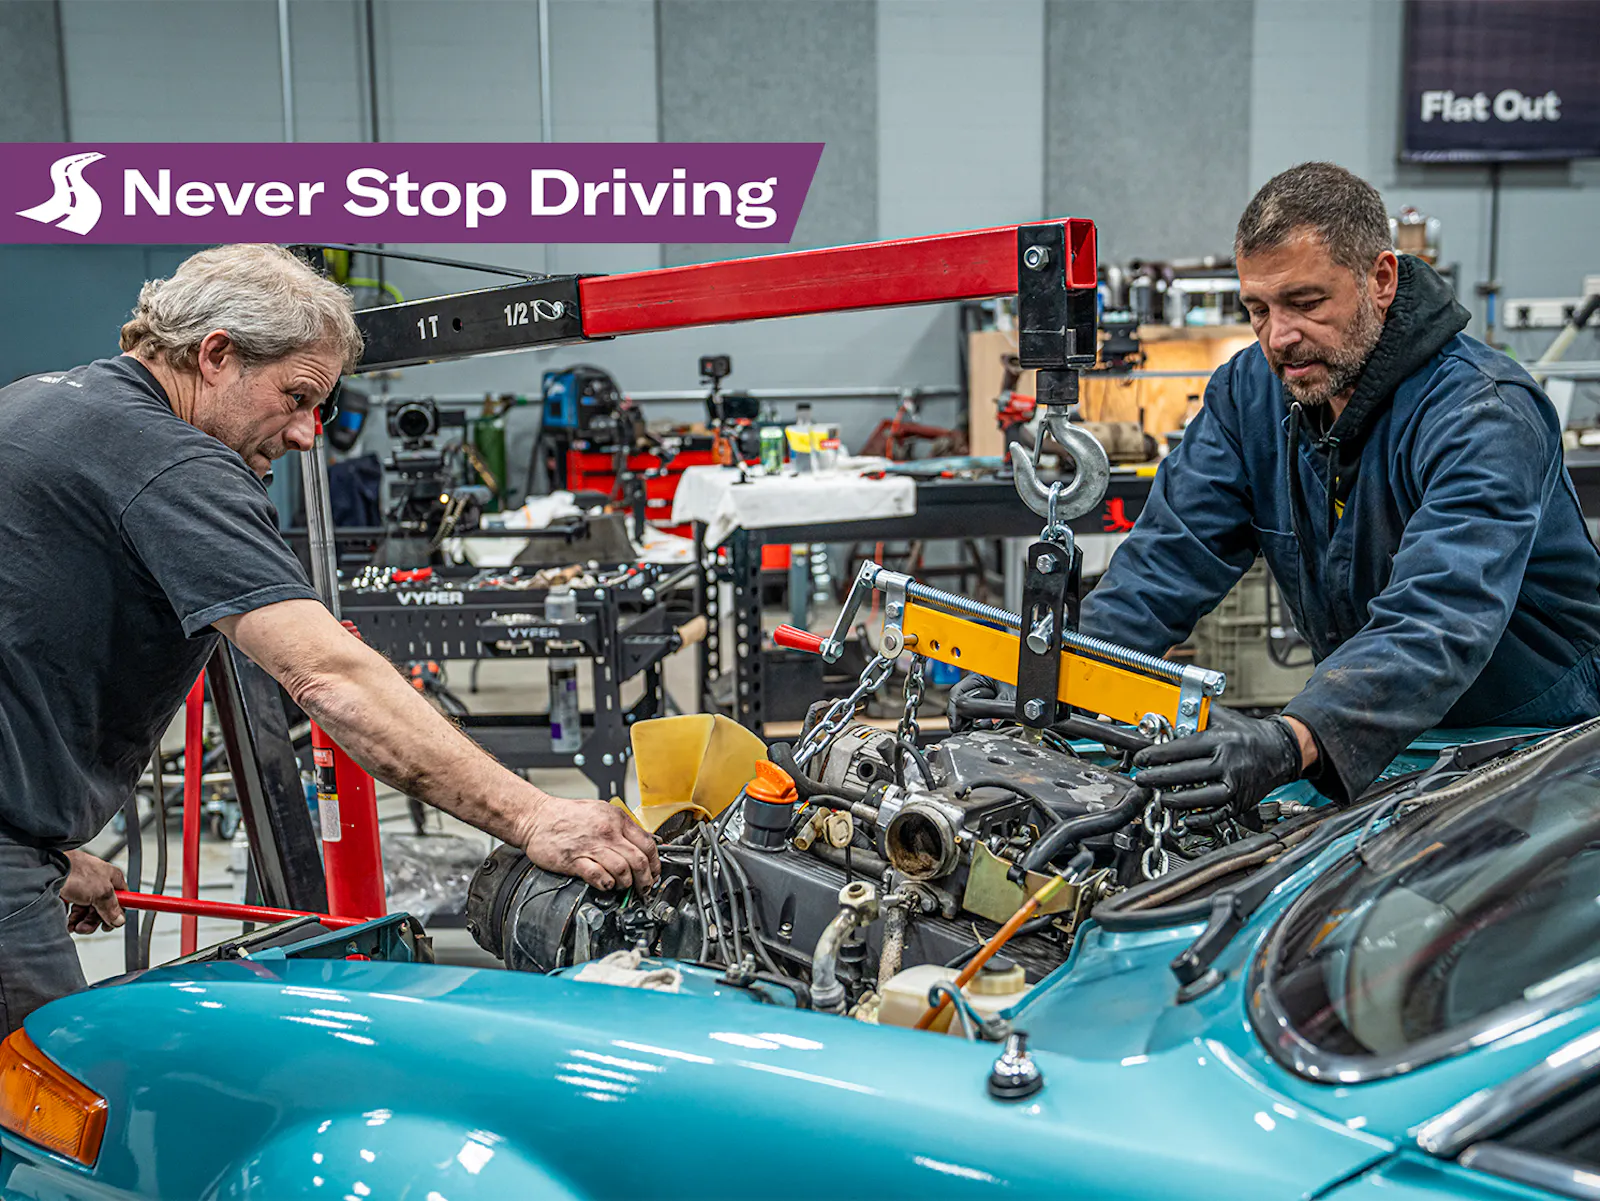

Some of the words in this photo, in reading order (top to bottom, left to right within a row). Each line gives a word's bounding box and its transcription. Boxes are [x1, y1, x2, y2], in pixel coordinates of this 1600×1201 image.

[1421, 90, 1490, 122] Flat
[1493, 89, 1561, 122] Out
[504, 302, 529, 326] 1/2
[397, 591, 464, 605] VYPER
